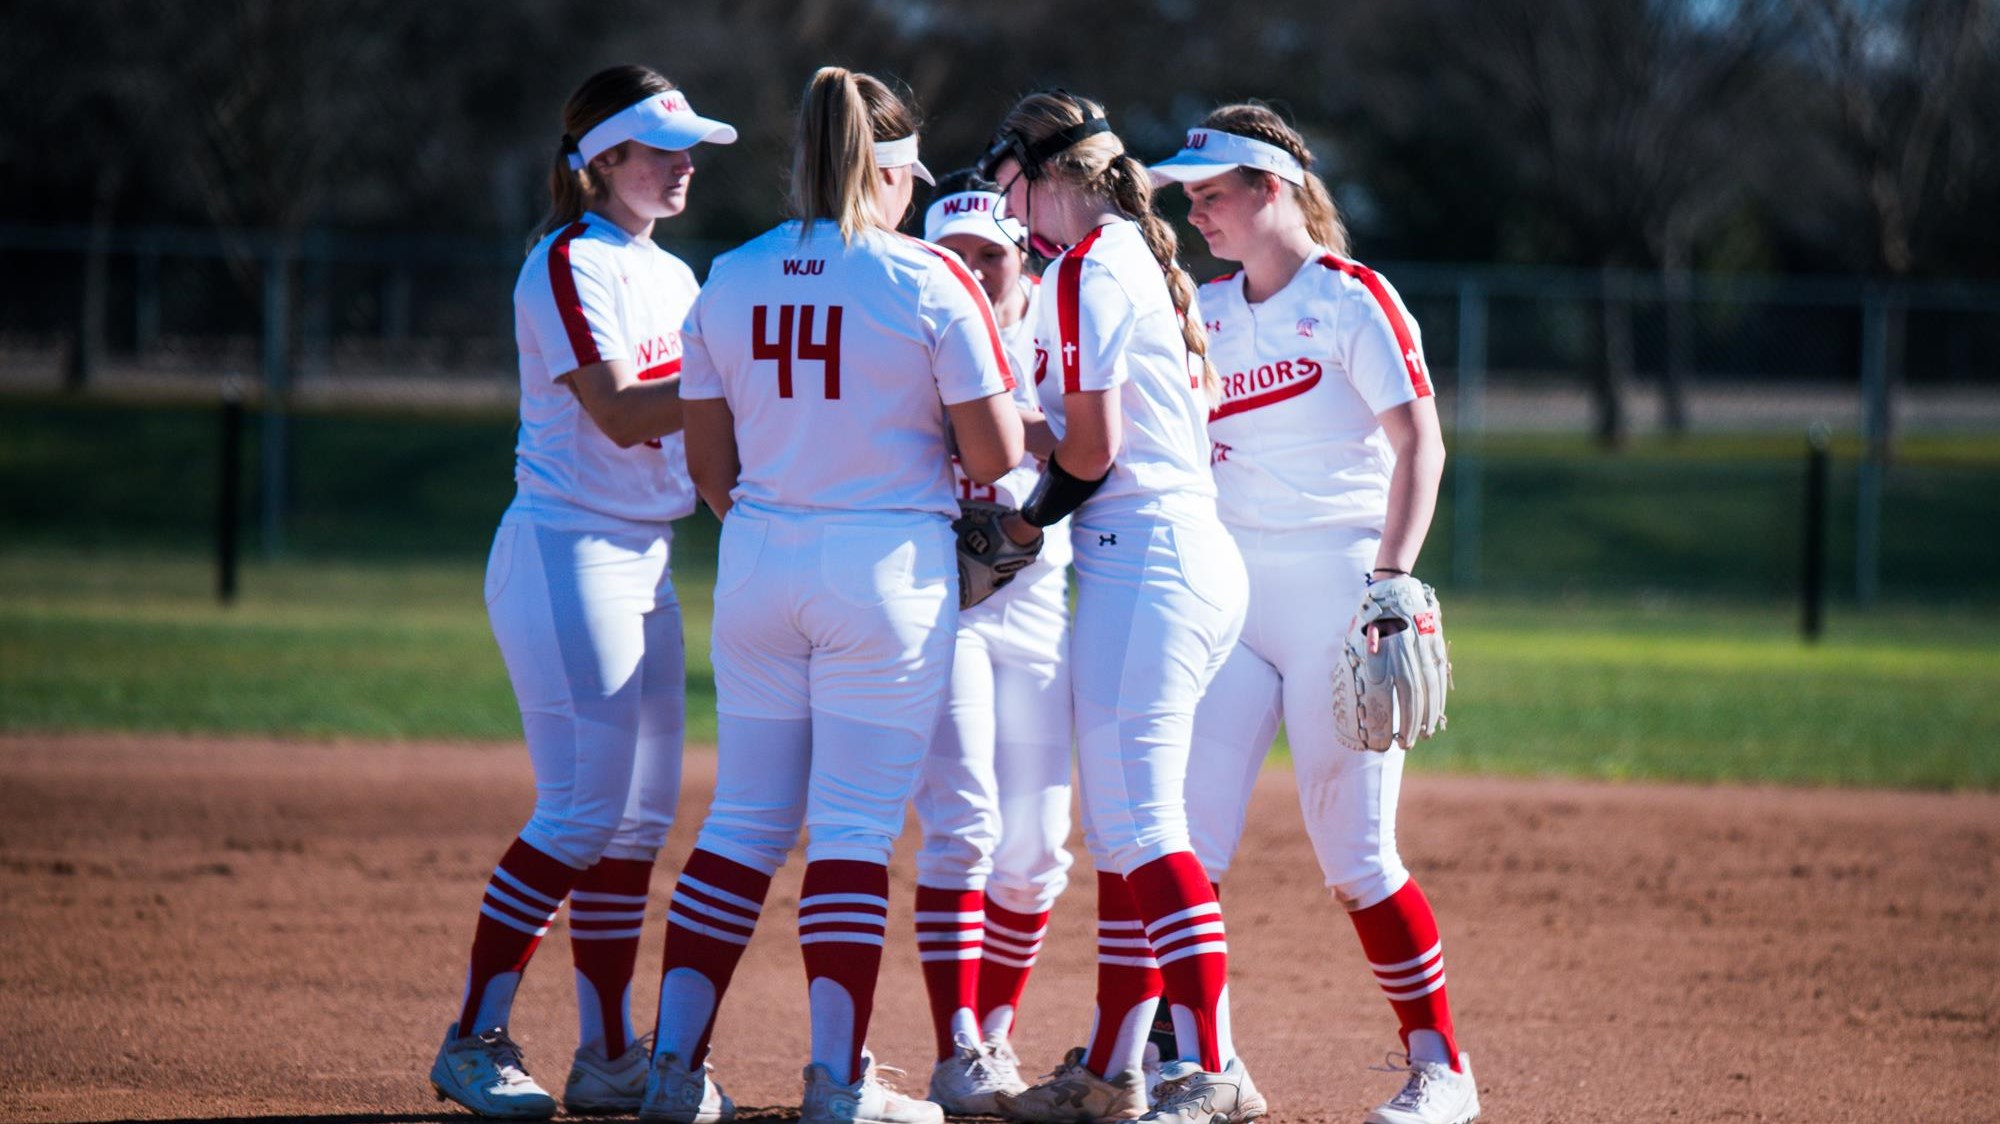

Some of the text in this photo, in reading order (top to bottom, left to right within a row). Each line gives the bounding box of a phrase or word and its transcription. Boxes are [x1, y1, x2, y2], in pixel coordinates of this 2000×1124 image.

[943, 197, 988, 216] WJU
[783, 259, 825, 276] WJU
[634, 327, 683, 367] WAR
[752, 304, 843, 400] 44
